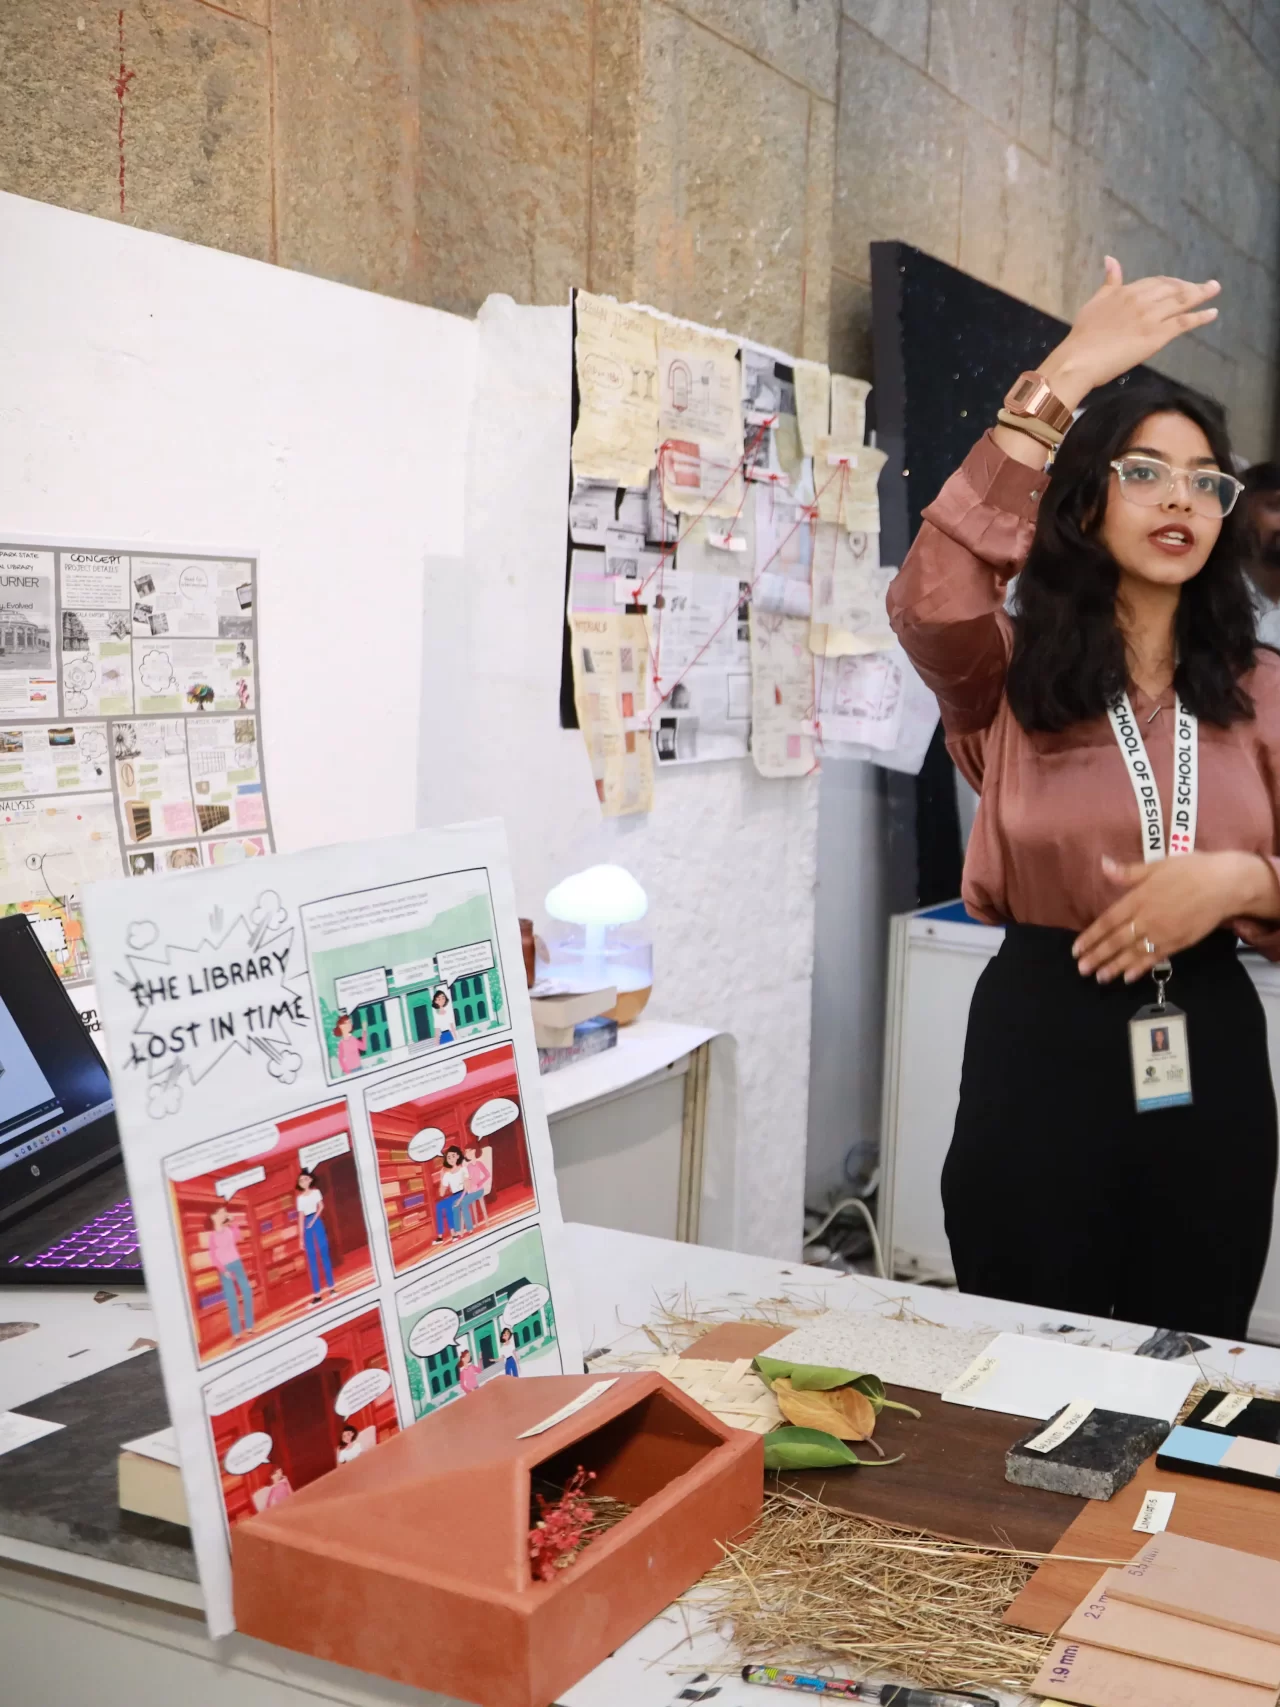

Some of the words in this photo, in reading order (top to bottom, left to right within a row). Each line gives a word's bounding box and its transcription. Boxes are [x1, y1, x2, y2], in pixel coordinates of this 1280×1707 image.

[64, 563, 91, 572] PROJECT
[92, 564, 119, 573] DETAILS
[70, 554, 122, 564] CONCEPT
[0, 576, 40, 588] URNER
[6, 602, 33, 610] Evolved
[1110, 696, 1141, 757] SCHOOL
[1179, 719, 1191, 740] OF
[1133, 760, 1150, 781] OF
[1178, 745, 1191, 806] SCHOOL
[1140, 786, 1161, 850] DESIGN
[1175, 810, 1190, 831] JD
[130, 976, 180, 1008] THE
[188, 948, 291, 995] LIBRARY
[130, 1022, 201, 1064] LOST
[210, 1012, 234, 1042] IN
[243, 996, 306, 1032] TIME
[1060, 1645, 1080, 1666] mm
[1050, 1667, 1071, 1683] 1.9
